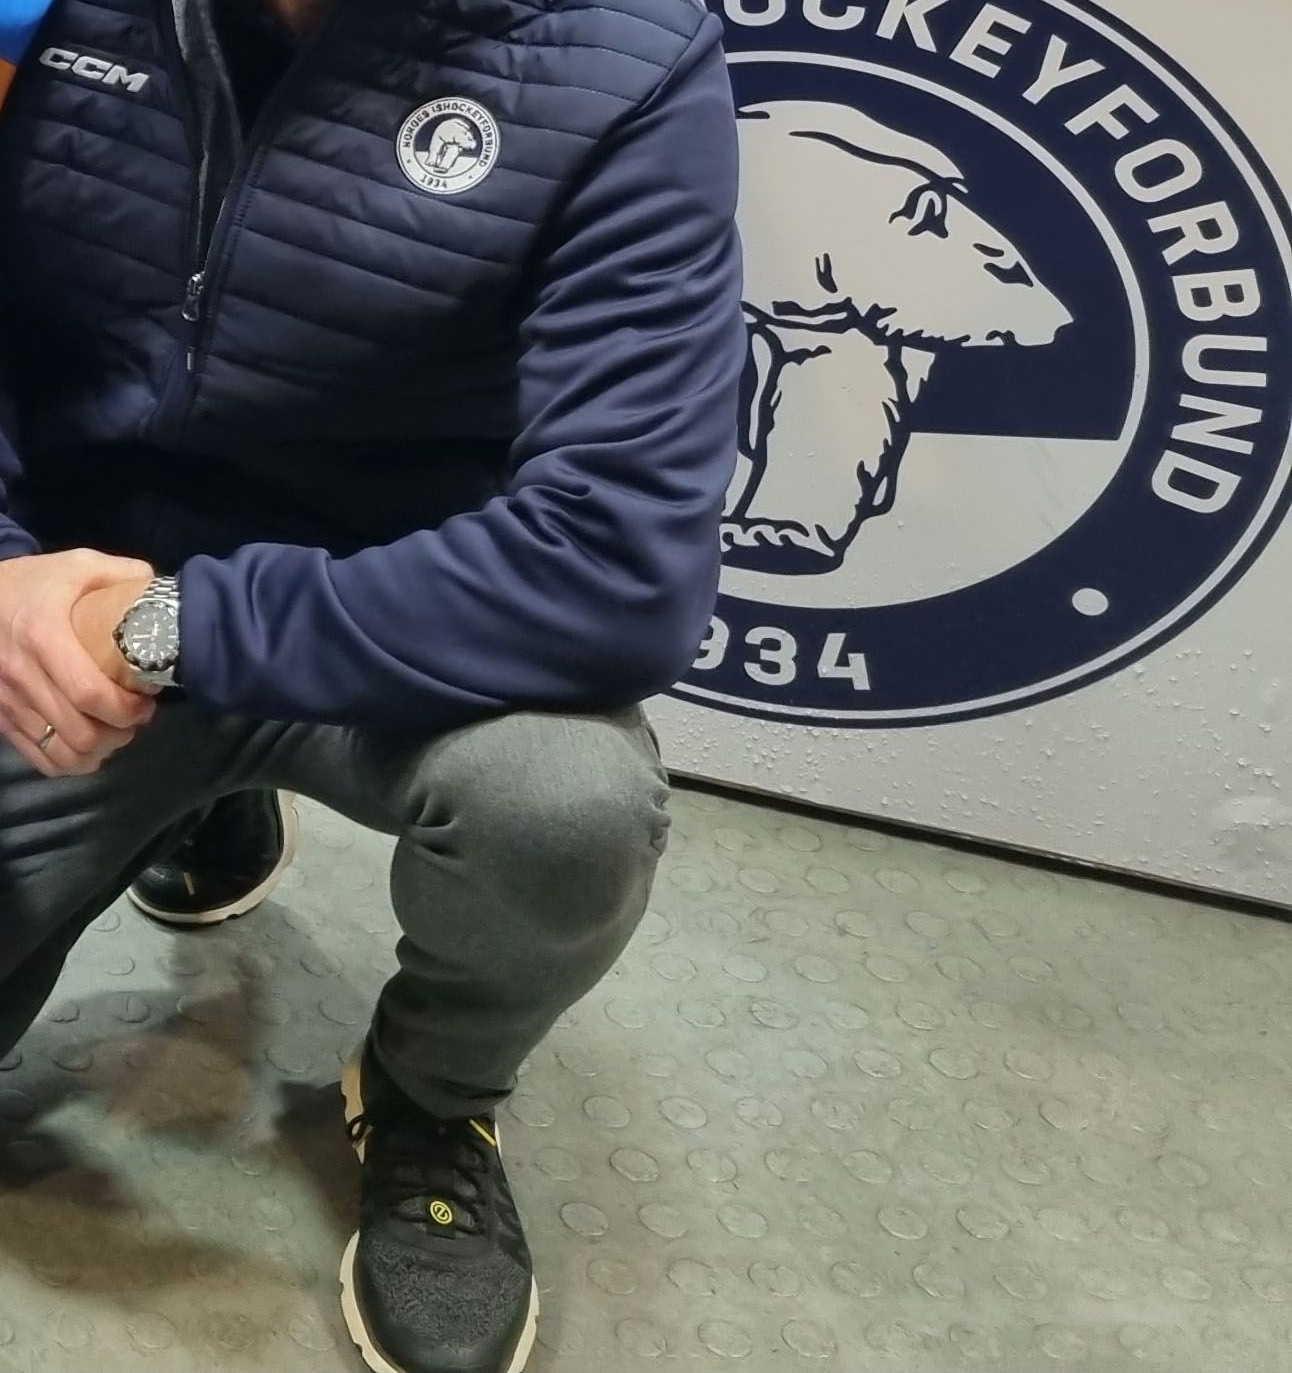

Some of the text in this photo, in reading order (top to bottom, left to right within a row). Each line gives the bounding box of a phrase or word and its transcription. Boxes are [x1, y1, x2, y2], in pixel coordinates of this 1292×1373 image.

[38, 46, 151, 93] CCM
[420, 174, 448, 189] 1934
[690, 622, 873, 693] 934
